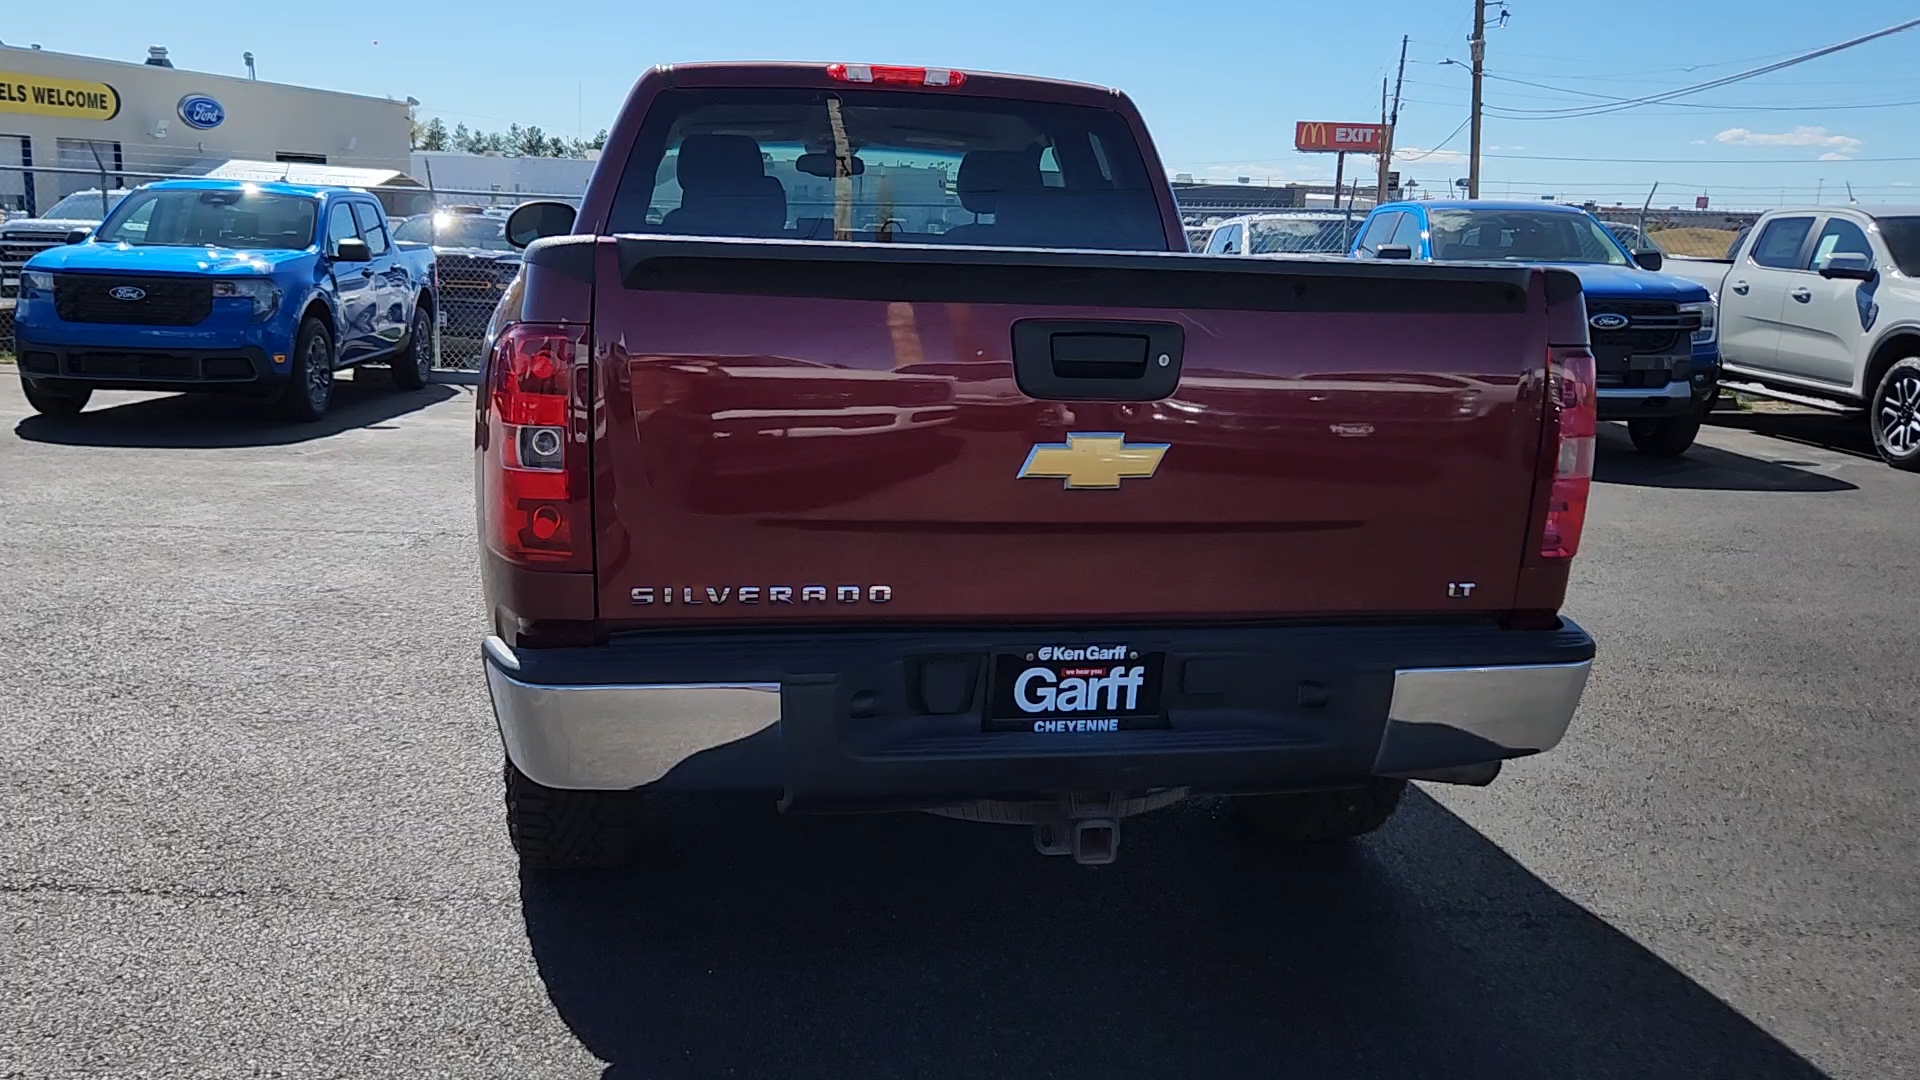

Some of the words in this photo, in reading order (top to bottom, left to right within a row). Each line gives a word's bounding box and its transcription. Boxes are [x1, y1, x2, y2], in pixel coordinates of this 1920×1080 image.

[0, 82, 27, 102] ELS
[32, 85, 108, 110] WELCOME
[1335, 127, 1375, 143] EXIT
[631, 585, 893, 605] SILVERADO
[1448, 582, 1476, 597] LT
[1053, 646, 1085, 661] Ken
[1086, 645, 1127, 660] Garff
[1013, 666, 1145, 713] Garff
[1033, 718, 1119, 733] CHEYENNE
